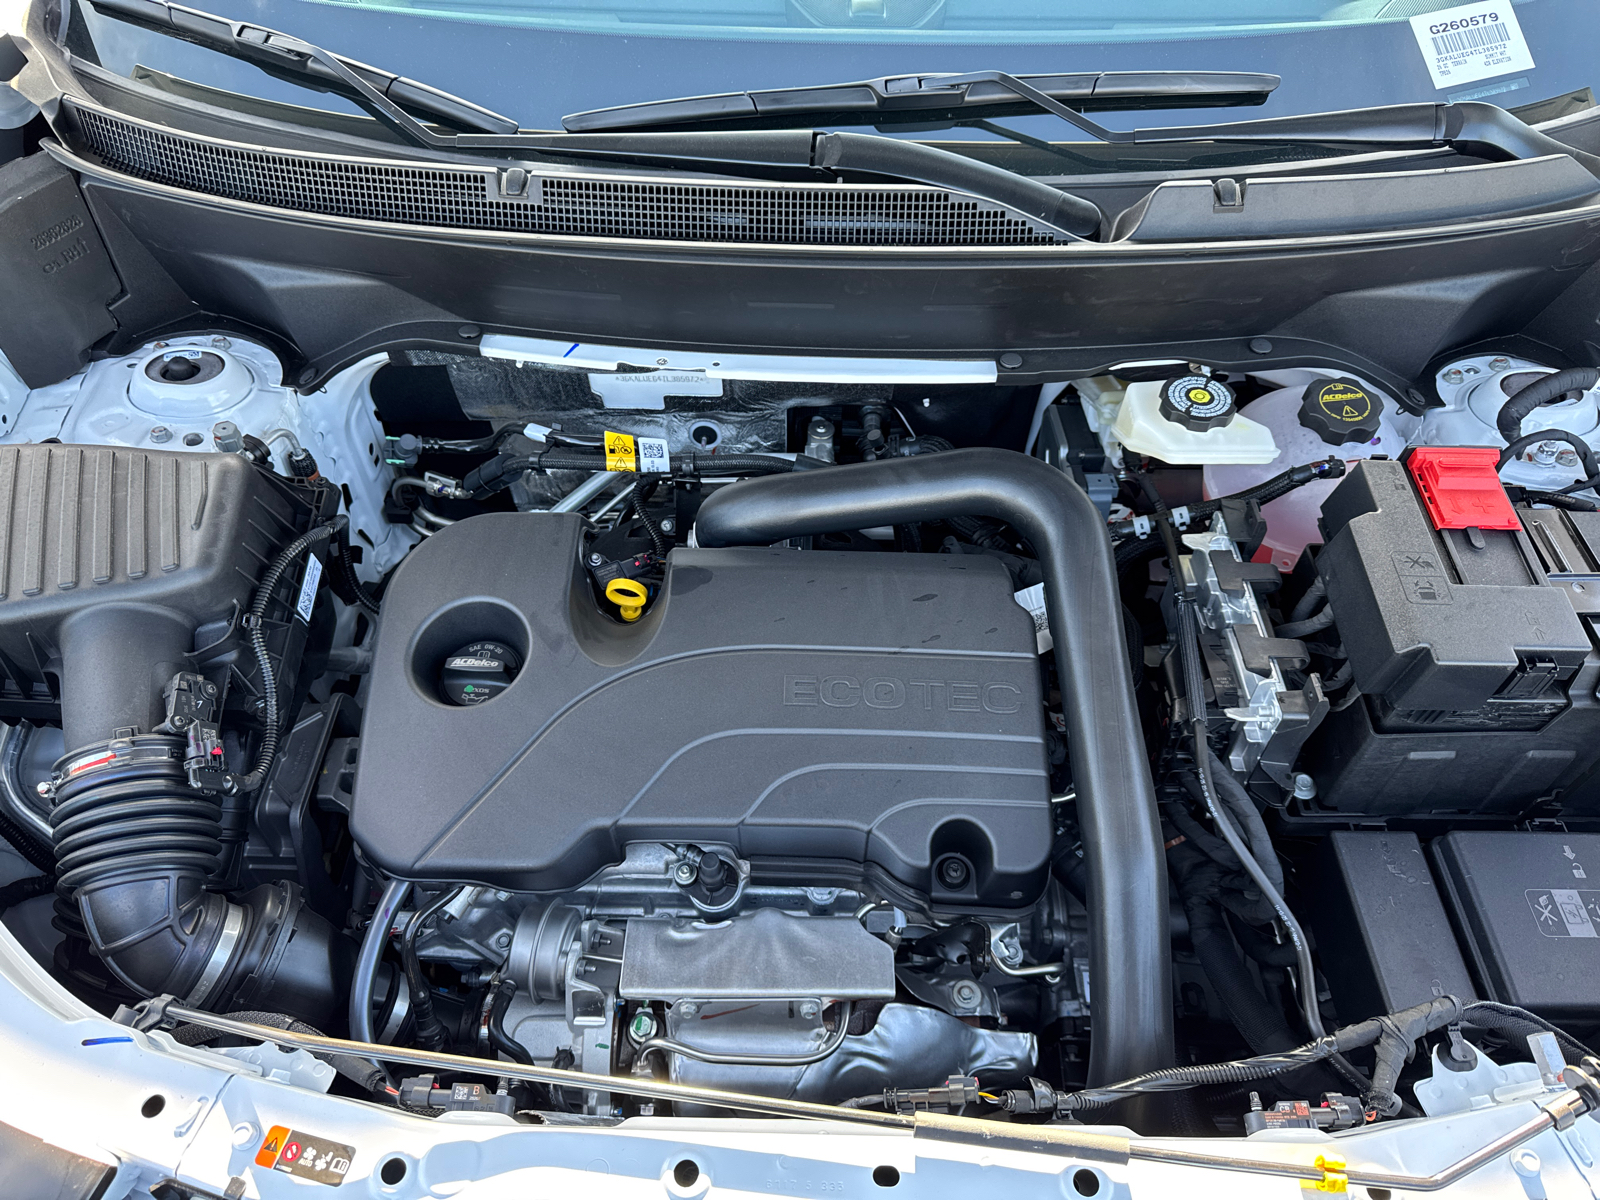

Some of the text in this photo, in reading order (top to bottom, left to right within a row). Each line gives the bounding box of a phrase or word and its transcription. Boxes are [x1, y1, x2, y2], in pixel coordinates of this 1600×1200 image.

[1429, 12, 1499, 35] G260579
[1435, 43, 1508, 63] 3GKALUEG4TL385972
[1322, 393, 1364, 402] ACDelco
[469, 644, 481, 652] SAE
[451, 658, 499, 667] ACDelco
[784, 675, 1022, 714] ECOTEC
